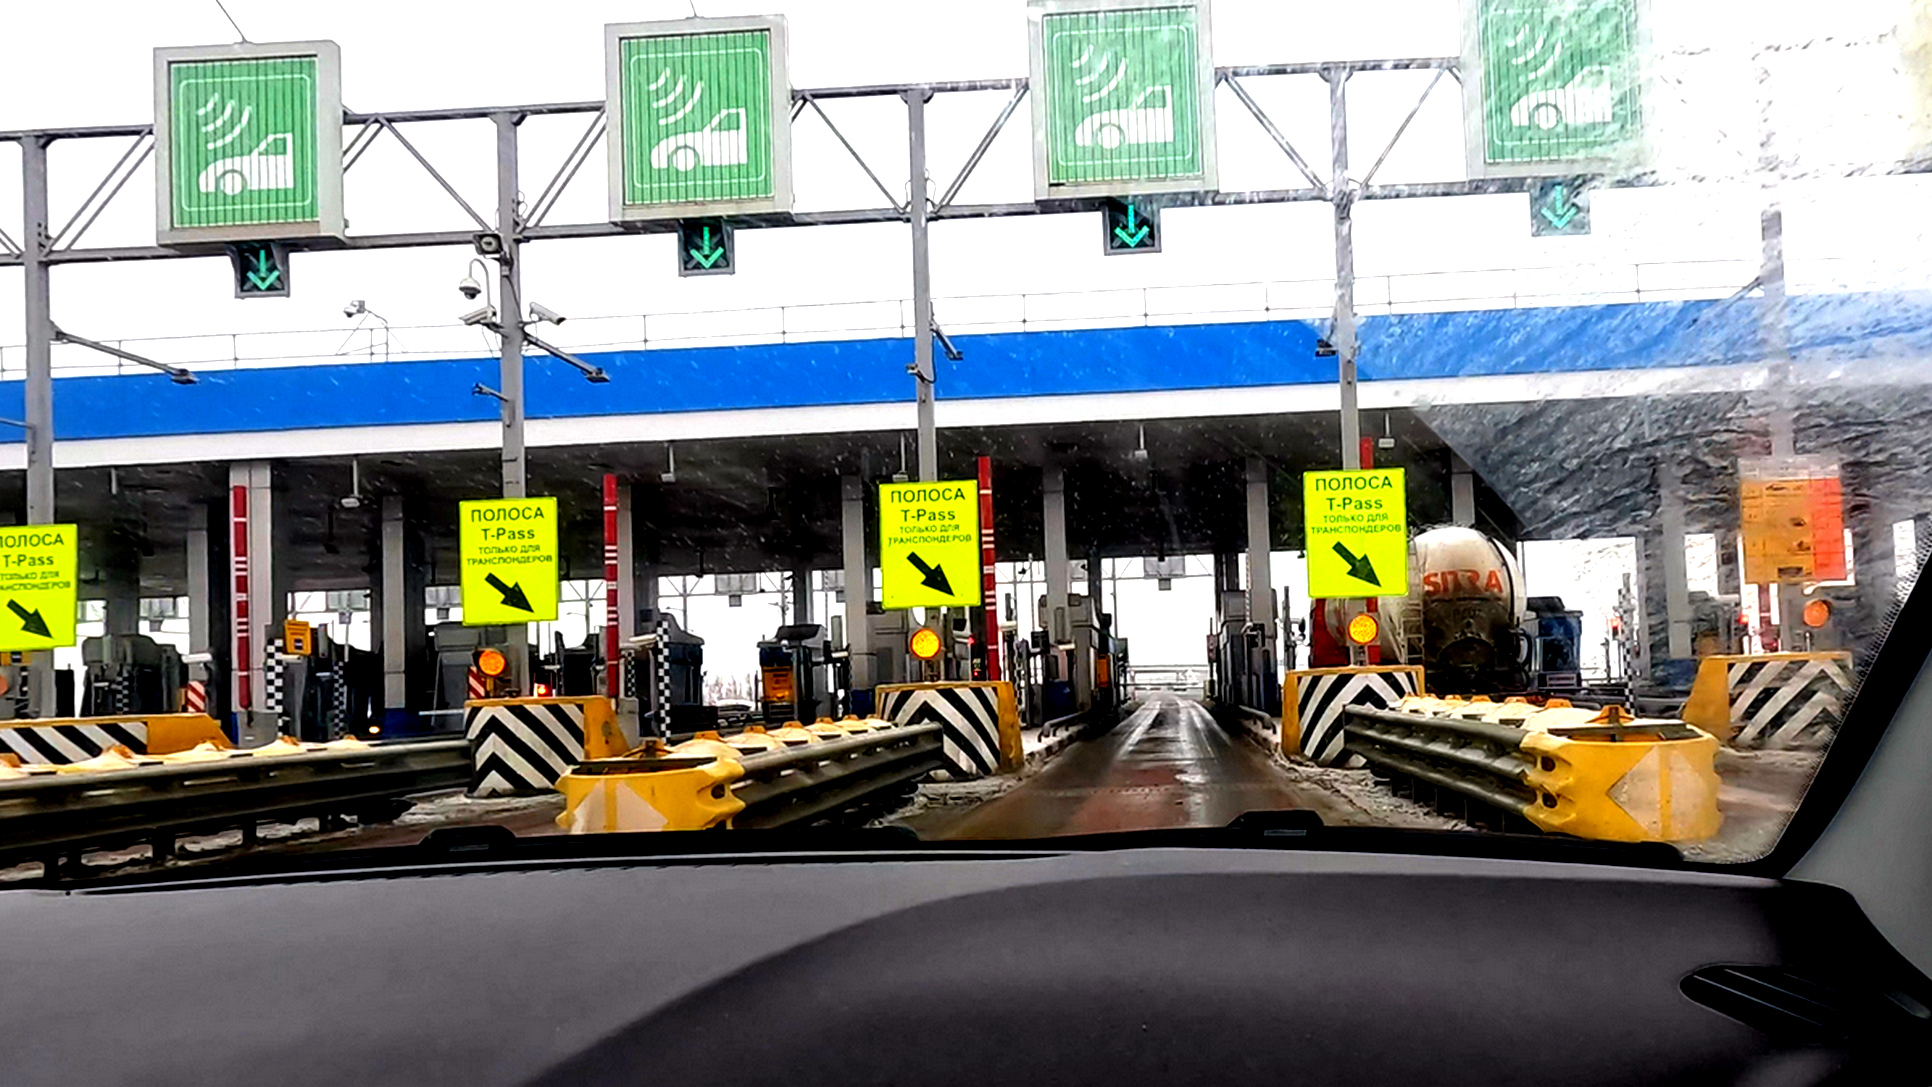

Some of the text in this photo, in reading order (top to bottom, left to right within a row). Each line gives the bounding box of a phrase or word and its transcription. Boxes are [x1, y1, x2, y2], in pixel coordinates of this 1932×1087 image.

[1315, 475, 1393, 492] ПОЛОСА
[890, 487, 966, 504] ПОЛОСА
[1325, 496, 1383, 511] T-Pass
[470, 505, 545, 523] ПОЛОСА
[900, 508, 956, 522] T-Pass
[1323, 512, 1389, 524] ТОЛЬКО ДЛЯ
[480, 527, 536, 542] T-Pass
[899, 523, 960, 535] ТОЛЬКО ДЛЯ
[1311, 523, 1402, 535] ТРАНСПОНДЕРОВ
[0, 533, 65, 548] ОЛОСА
[887, 533, 972, 546] ТРАНСПОНДЕРОВ
[478, 543, 541, 555] ТОЛЬКО ДЛЯ
[2, 554, 55, 568] T-Pass
[466, 554, 553, 566] ТРАНСПОНДЕРОВ
[1423, 568, 1503, 598] SITRA
